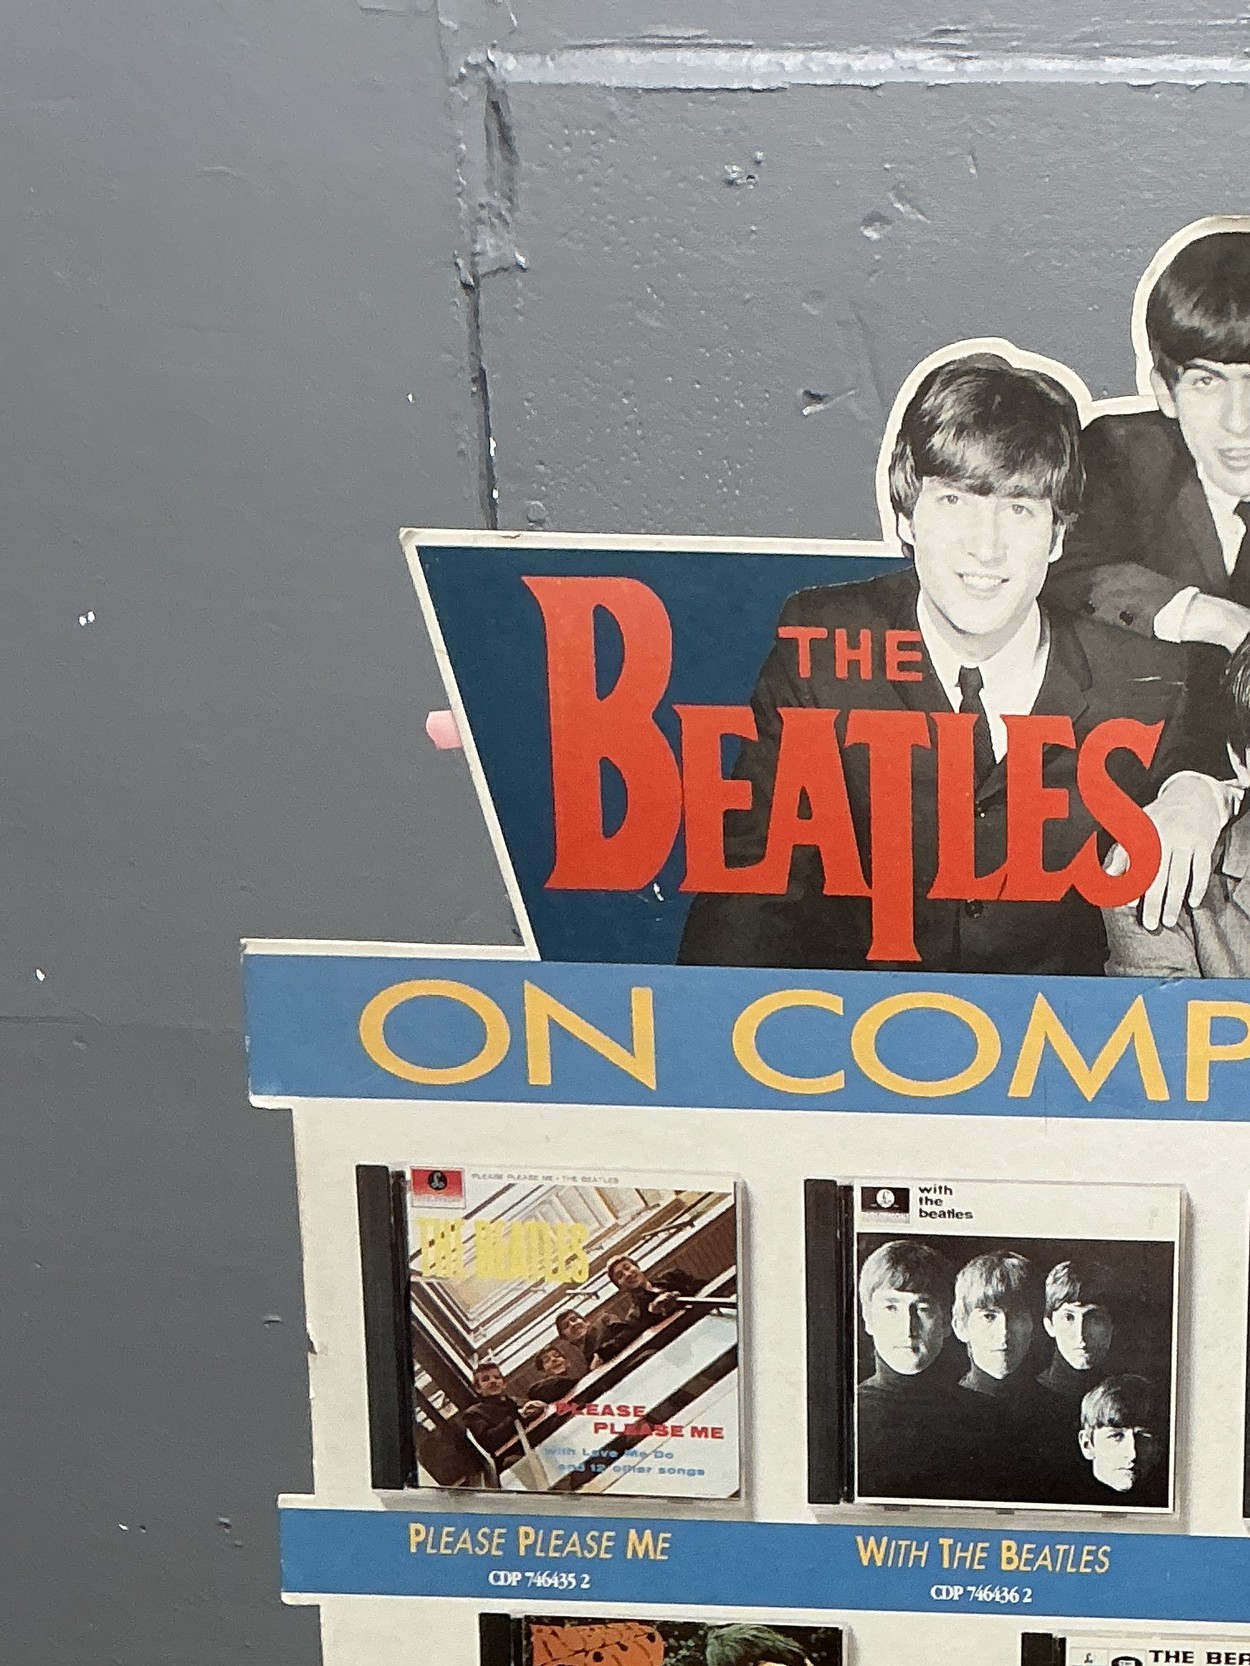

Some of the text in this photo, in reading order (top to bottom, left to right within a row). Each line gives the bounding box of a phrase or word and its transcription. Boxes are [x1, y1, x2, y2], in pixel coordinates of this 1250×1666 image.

[777, 626, 923, 682] THE
[521, 576, 1163, 962] BEATLES
[357, 978, 657, 1091] ON
[919, 1185, 953, 1196] with
[919, 1196, 943, 1206] the
[919, 1208, 973, 1219] beatles
[555, 1402, 647, 1418] PLEASE
[593, 1422, 724, 1440] PLEASE ME
[658, 1467, 705, 1477] songs
[409, 1522, 672, 1561] PLEASE PLEASE ME
[856, 1536, 1111, 1574] WITH THE BEATLES
[488, 1570, 590, 1589] CDP 746435 2
[931, 1585, 1032, 1603] CDP 746436 2
[1149, 1650, 1194, 1664] THE
